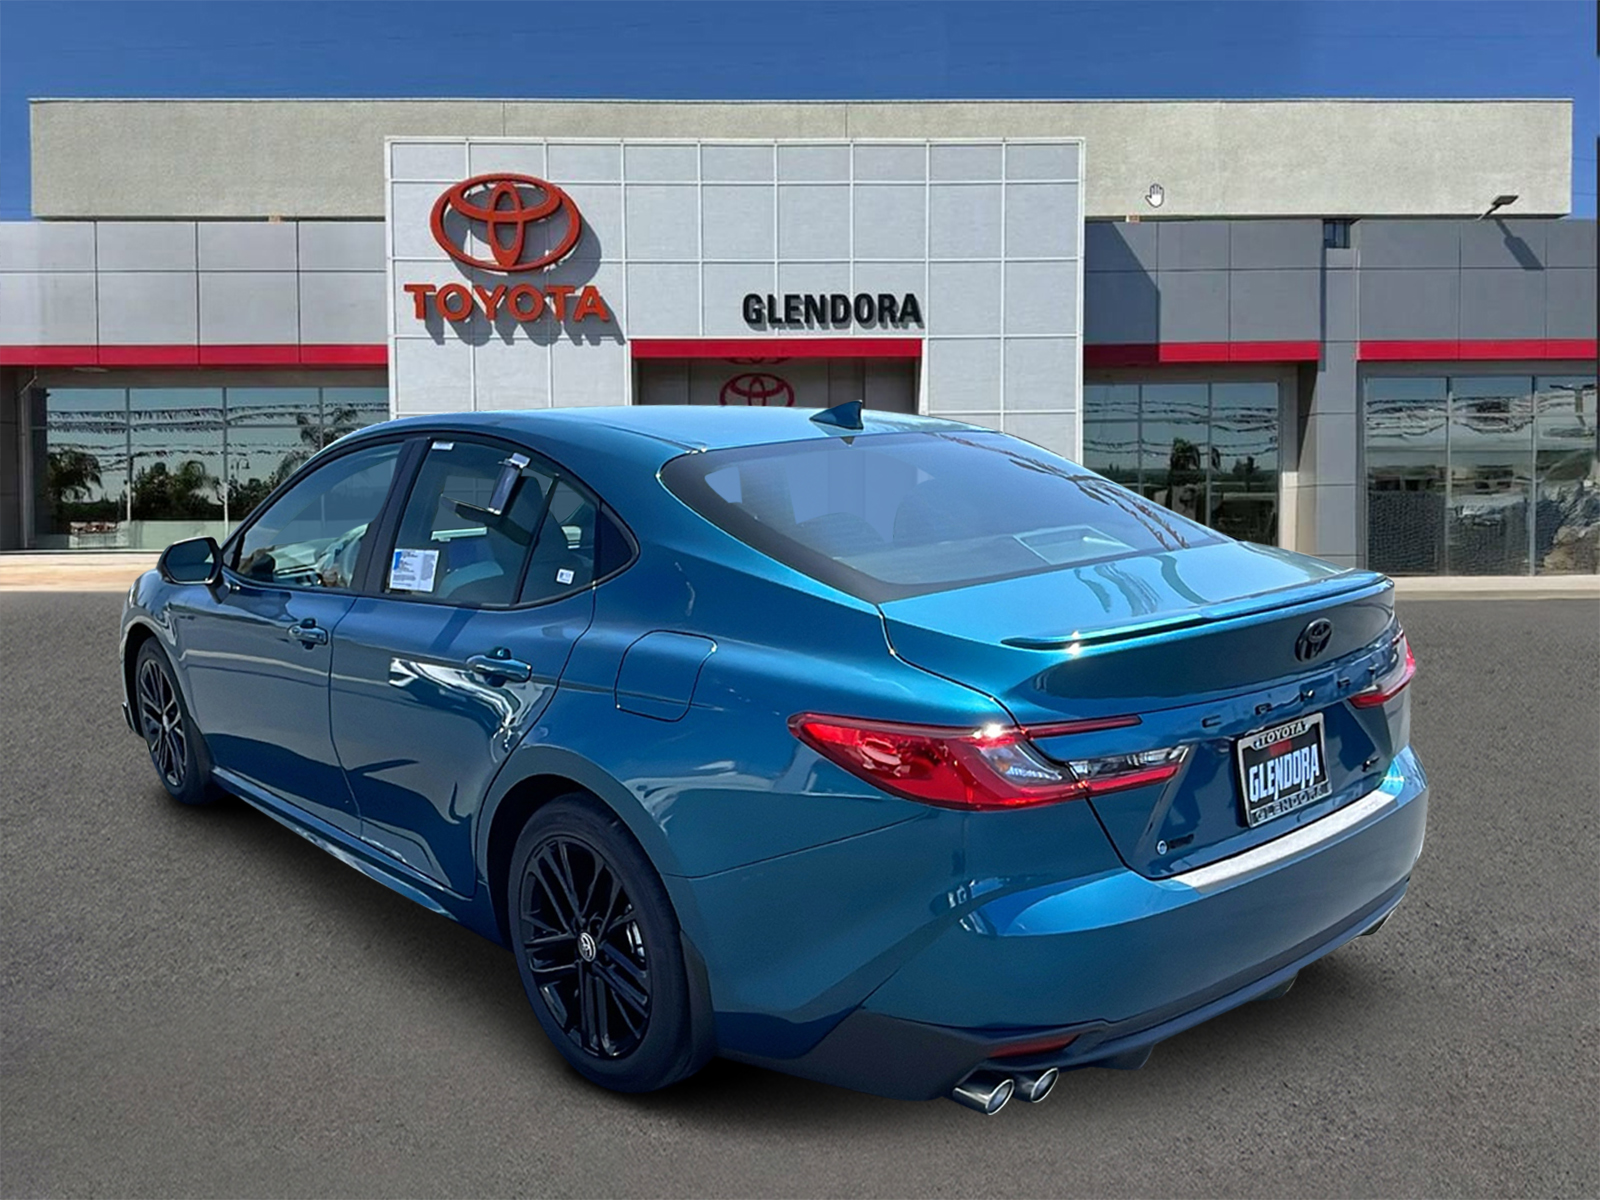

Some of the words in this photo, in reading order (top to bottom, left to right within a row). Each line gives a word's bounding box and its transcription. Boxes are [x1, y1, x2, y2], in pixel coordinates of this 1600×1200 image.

[404, 283, 610, 322] TOYOTA
[743, 293, 922, 325] GLENDORA
[1259, 720, 1304, 745] TOYOTA
[1249, 743, 1320, 803] GLENDORA
